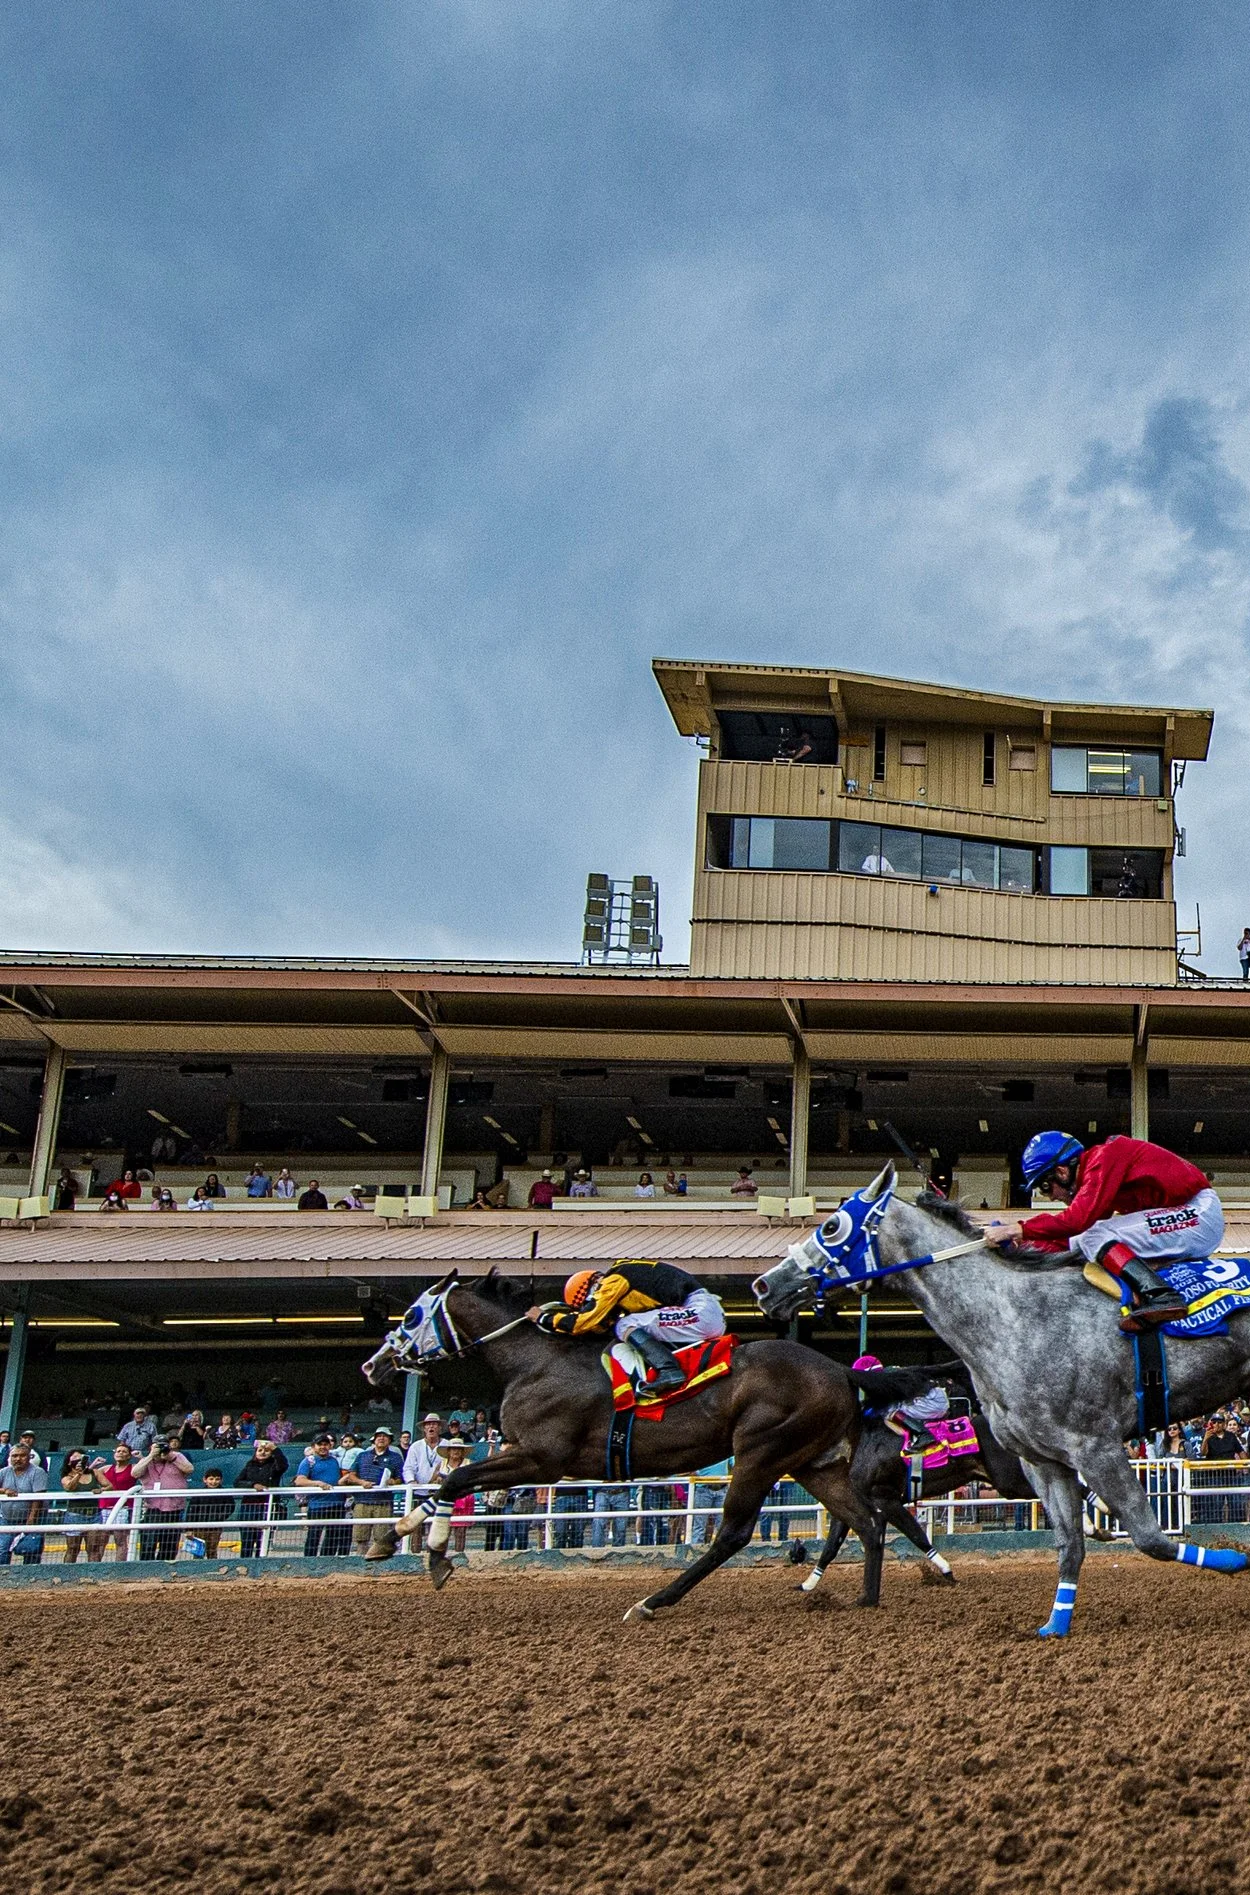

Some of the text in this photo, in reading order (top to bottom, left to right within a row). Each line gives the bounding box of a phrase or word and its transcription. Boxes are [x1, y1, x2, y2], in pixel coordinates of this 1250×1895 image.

[1145, 1208, 1199, 1228] track
[1149, 1217, 1200, 1236] MAGAZINE
[657, 1308, 699, 1321] track
[1170, 1299, 1232, 1330] TACTICAL
